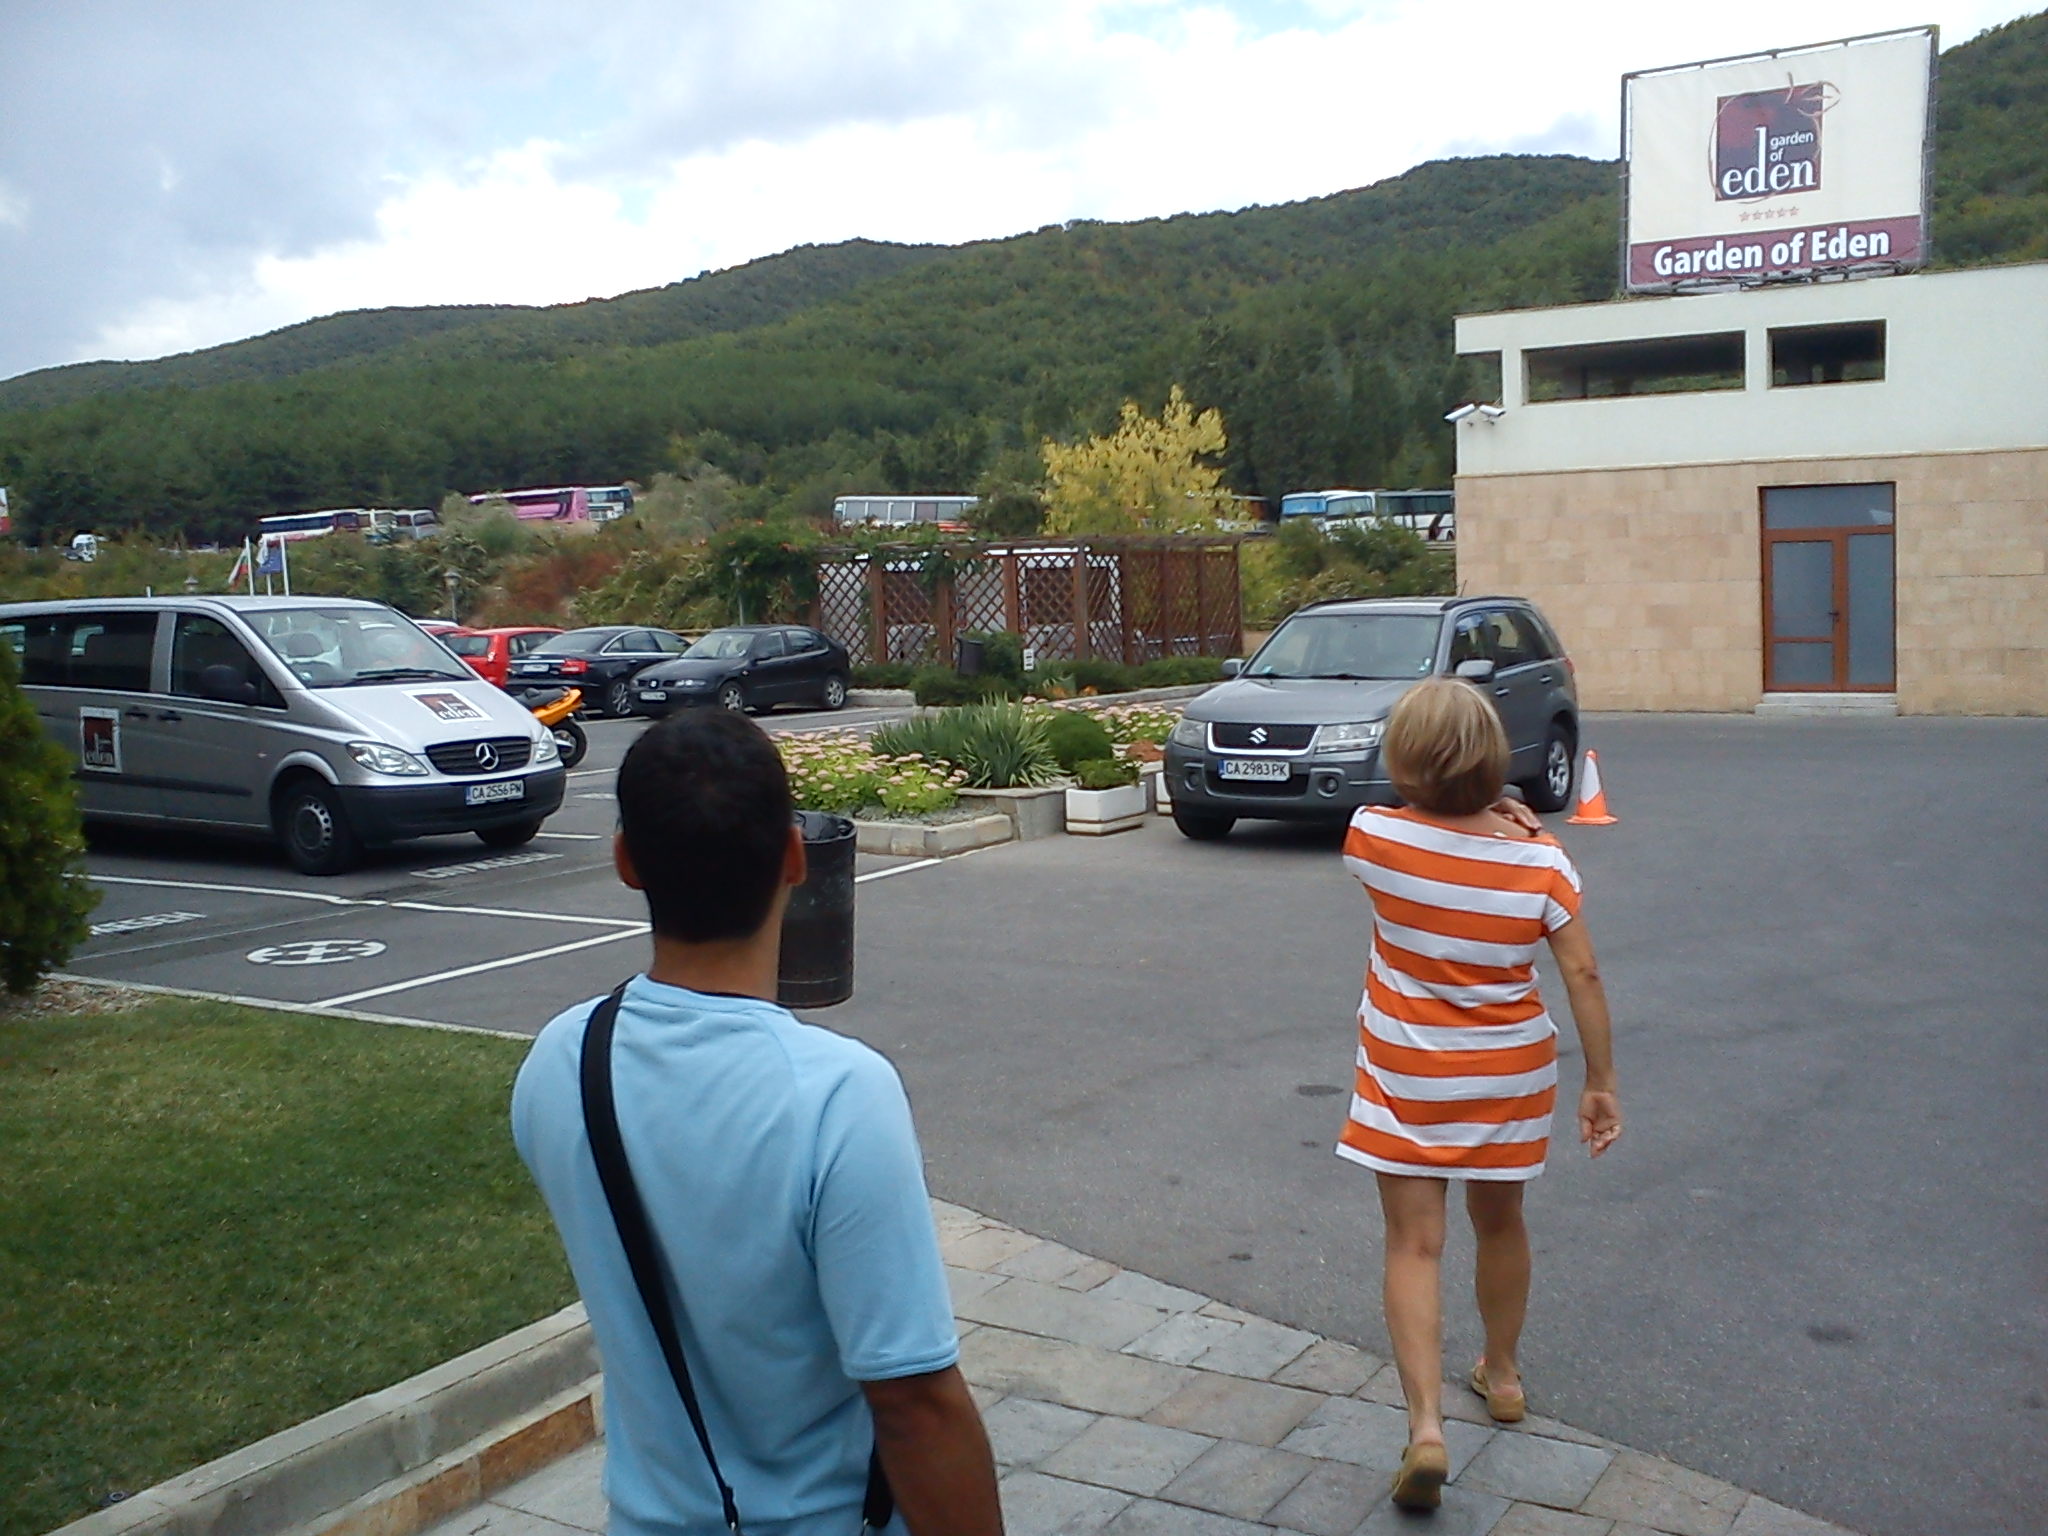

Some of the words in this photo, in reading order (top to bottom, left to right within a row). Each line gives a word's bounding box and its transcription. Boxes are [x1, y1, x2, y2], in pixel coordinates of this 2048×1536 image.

[1769, 130, 1814, 150] garden
[1721, 126, 1818, 196] eden
[1769, 147, 1784, 164] of
[1653, 240, 1764, 277] Garden
[1771, 232, 1805, 267] of
[1811, 227, 1890, 262] Eden
[1226, 761, 1241, 775] CA
[1242, 761, 1270, 776] 2983
[1271, 763, 1287, 777] PK
